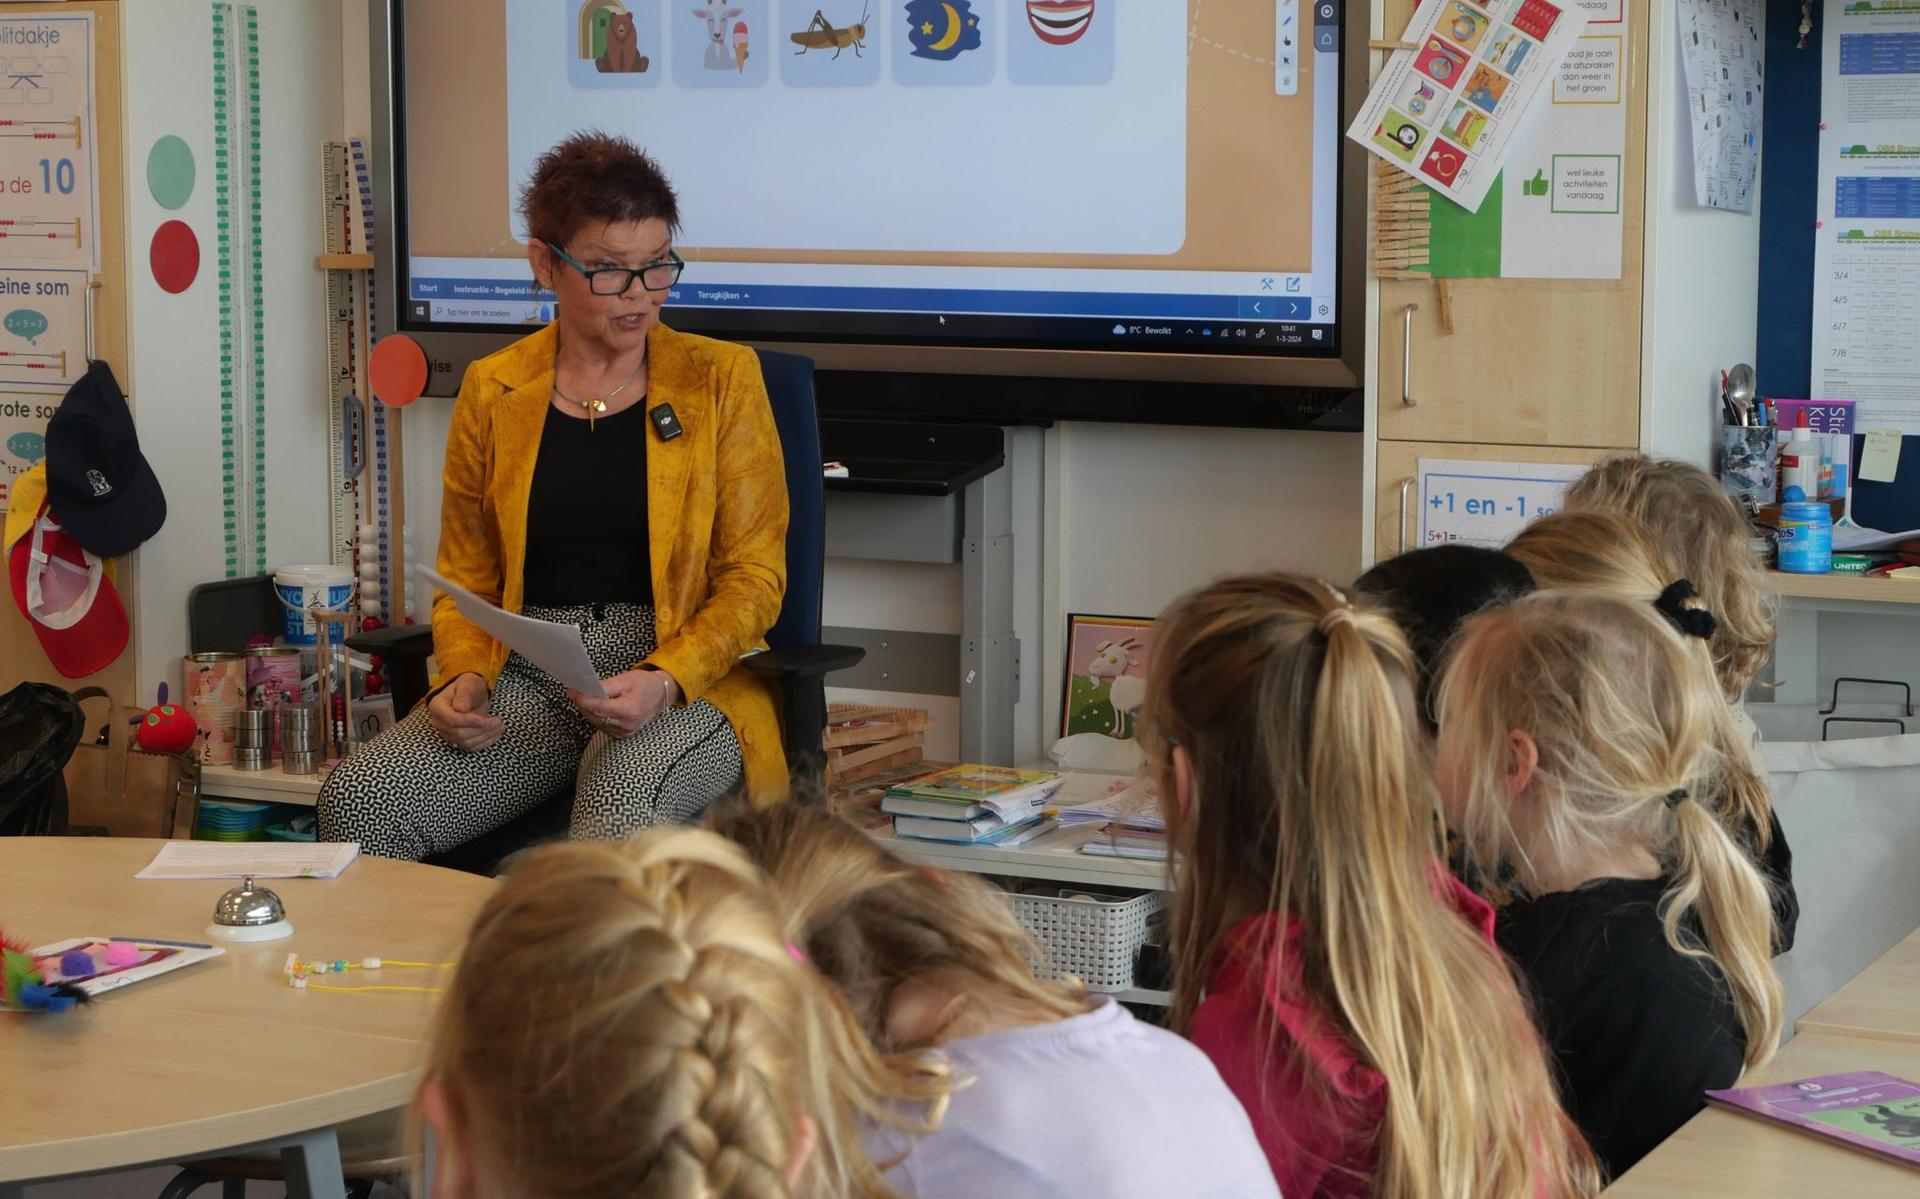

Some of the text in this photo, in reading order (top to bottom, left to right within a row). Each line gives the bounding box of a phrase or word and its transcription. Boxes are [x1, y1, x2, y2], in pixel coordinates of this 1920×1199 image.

[0, 26, 60, 48] litdakje
[1574, 62, 1614, 70] afspraken
[10, 176, 32, 193] de
[38, 158, 75, 194] 10
[1567, 192, 1605, 201] vandaag
[1834, 271, 1849, 280] 3/4
[36, 281, 69, 295] som
[419, 284, 438, 292] Start
[454, 285, 489, 294] Instructie
[697, 290, 740, 301] Terugkijken
[1833, 295, 1848, 304] 4/5
[1145, 326, 1172, 335] Bewolkt
[36, 405, 57, 419] so
[1430, 492, 1454, 513] +1
[1466, 497, 1495, 515] en
[1505, 496, 1526, 517] -1
